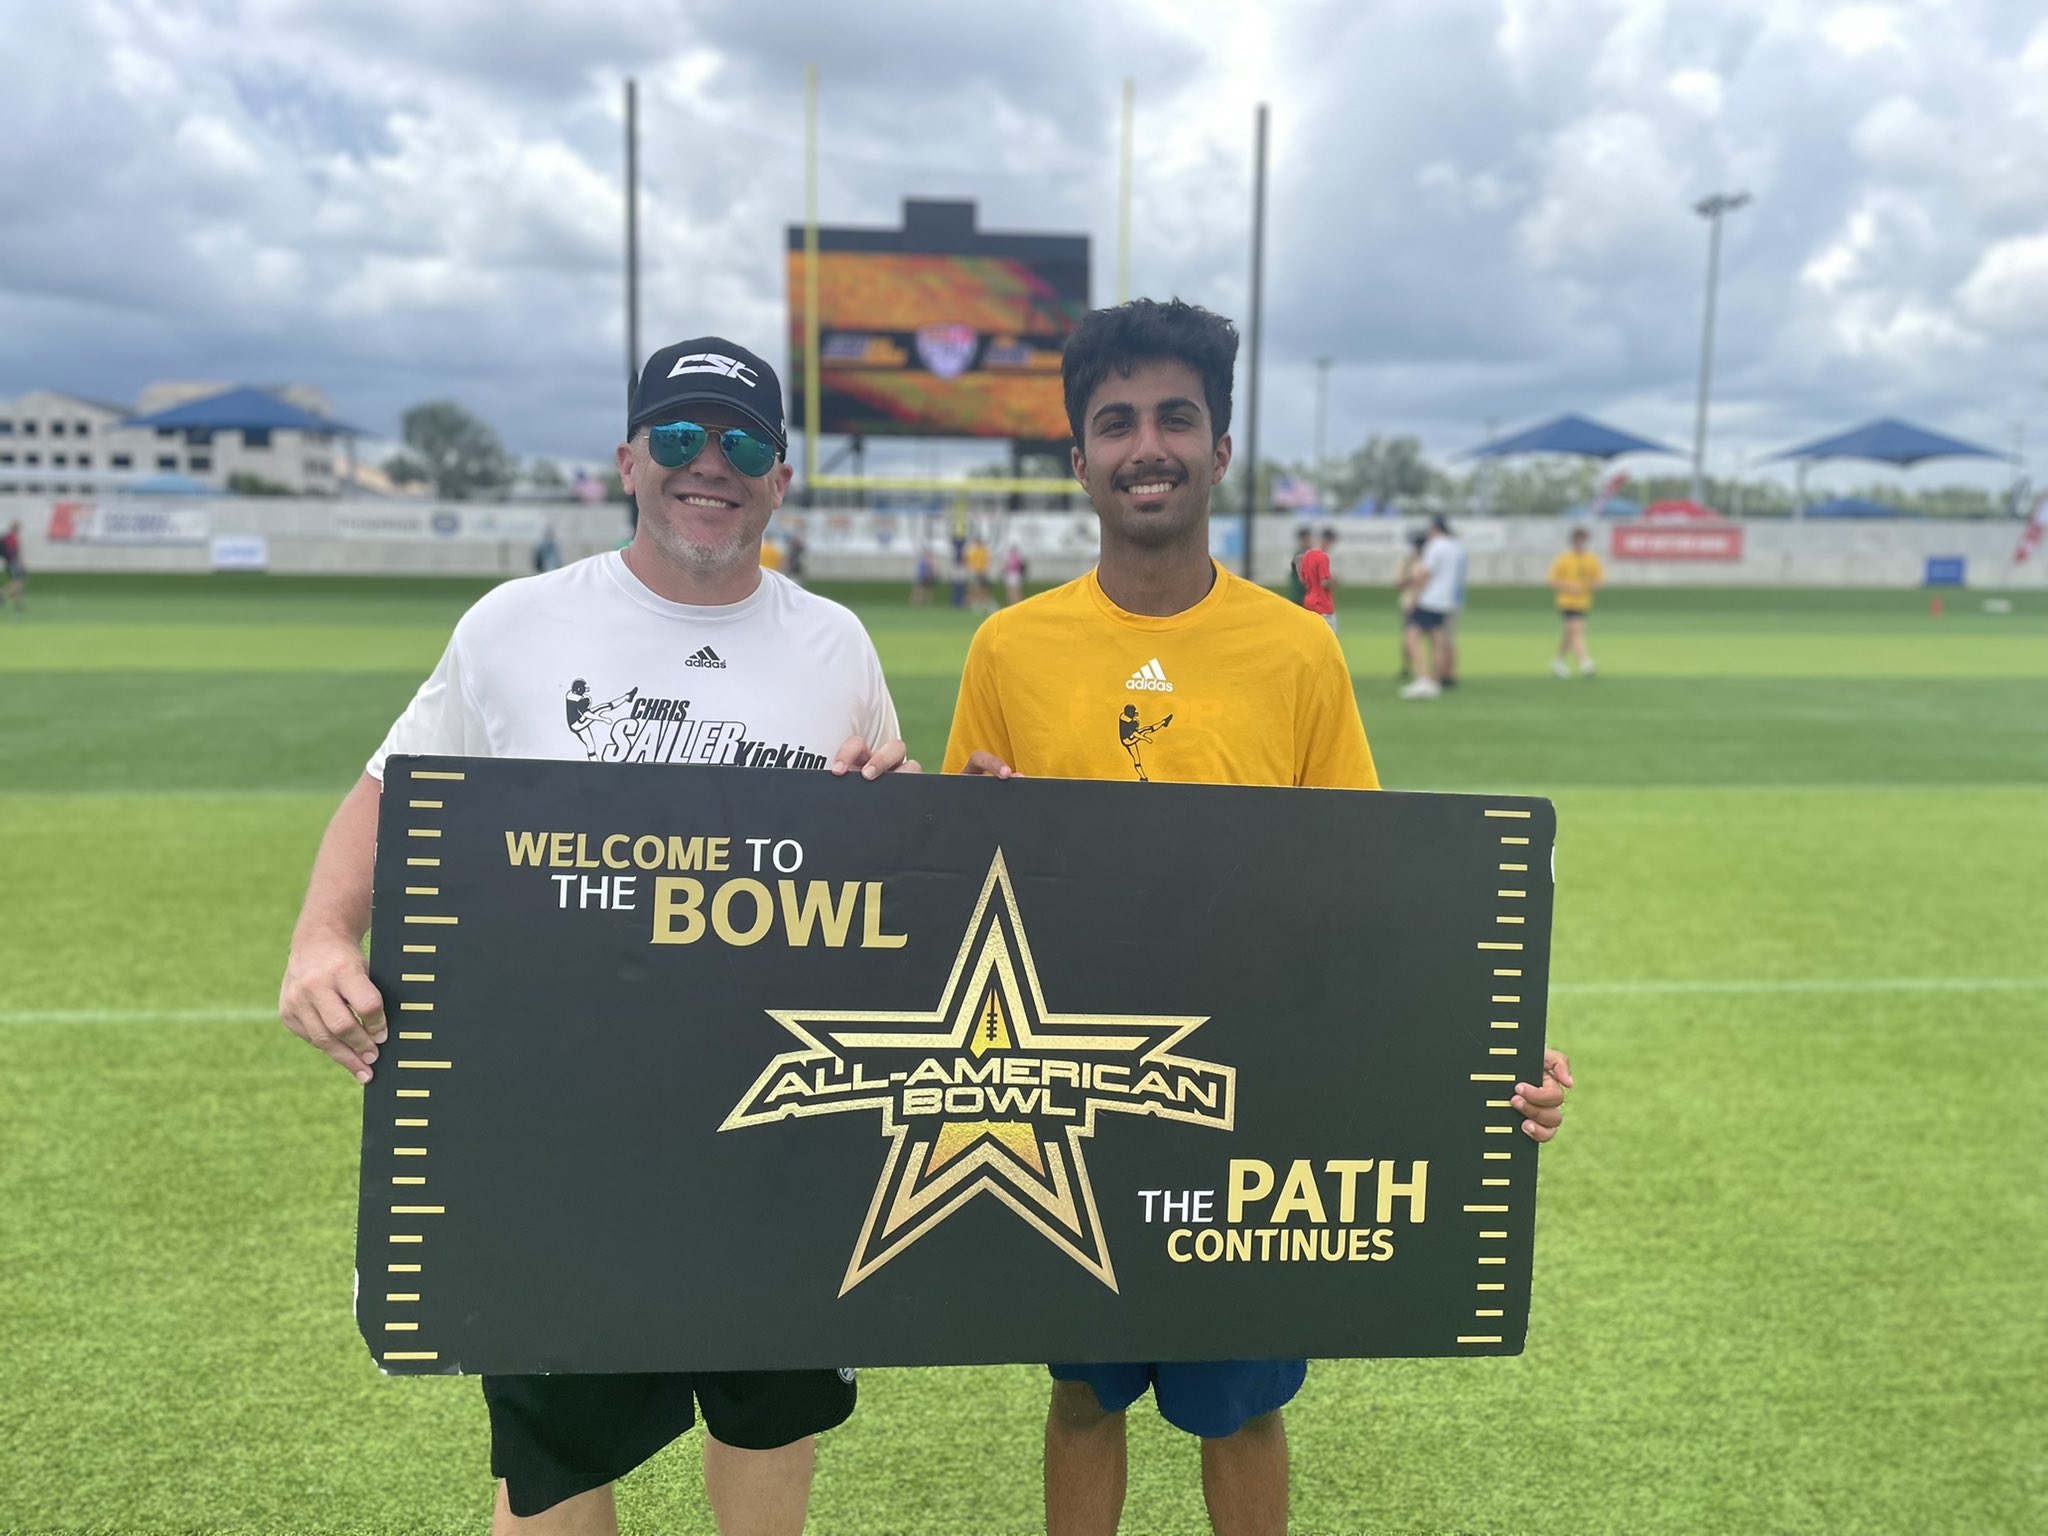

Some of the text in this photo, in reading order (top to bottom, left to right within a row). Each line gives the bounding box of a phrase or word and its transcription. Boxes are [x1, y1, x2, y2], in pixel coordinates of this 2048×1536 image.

[685, 659, 727, 669] adidas
[1125, 678, 1173, 692] adidas
[630, 698, 690, 720] CHRIS
[602, 718, 747, 764] SAILER
[504, 831, 804, 873] WELCOME TO
[550, 873, 908, 948] THE BOWL
[763, 1058, 1217, 1108] ALL-AMERICAN
[903, 1086, 1076, 1116] BOWL
[1137, 1158, 1429, 1223] THE PATH
[1167, 1228, 1394, 1262] CONTINUES
